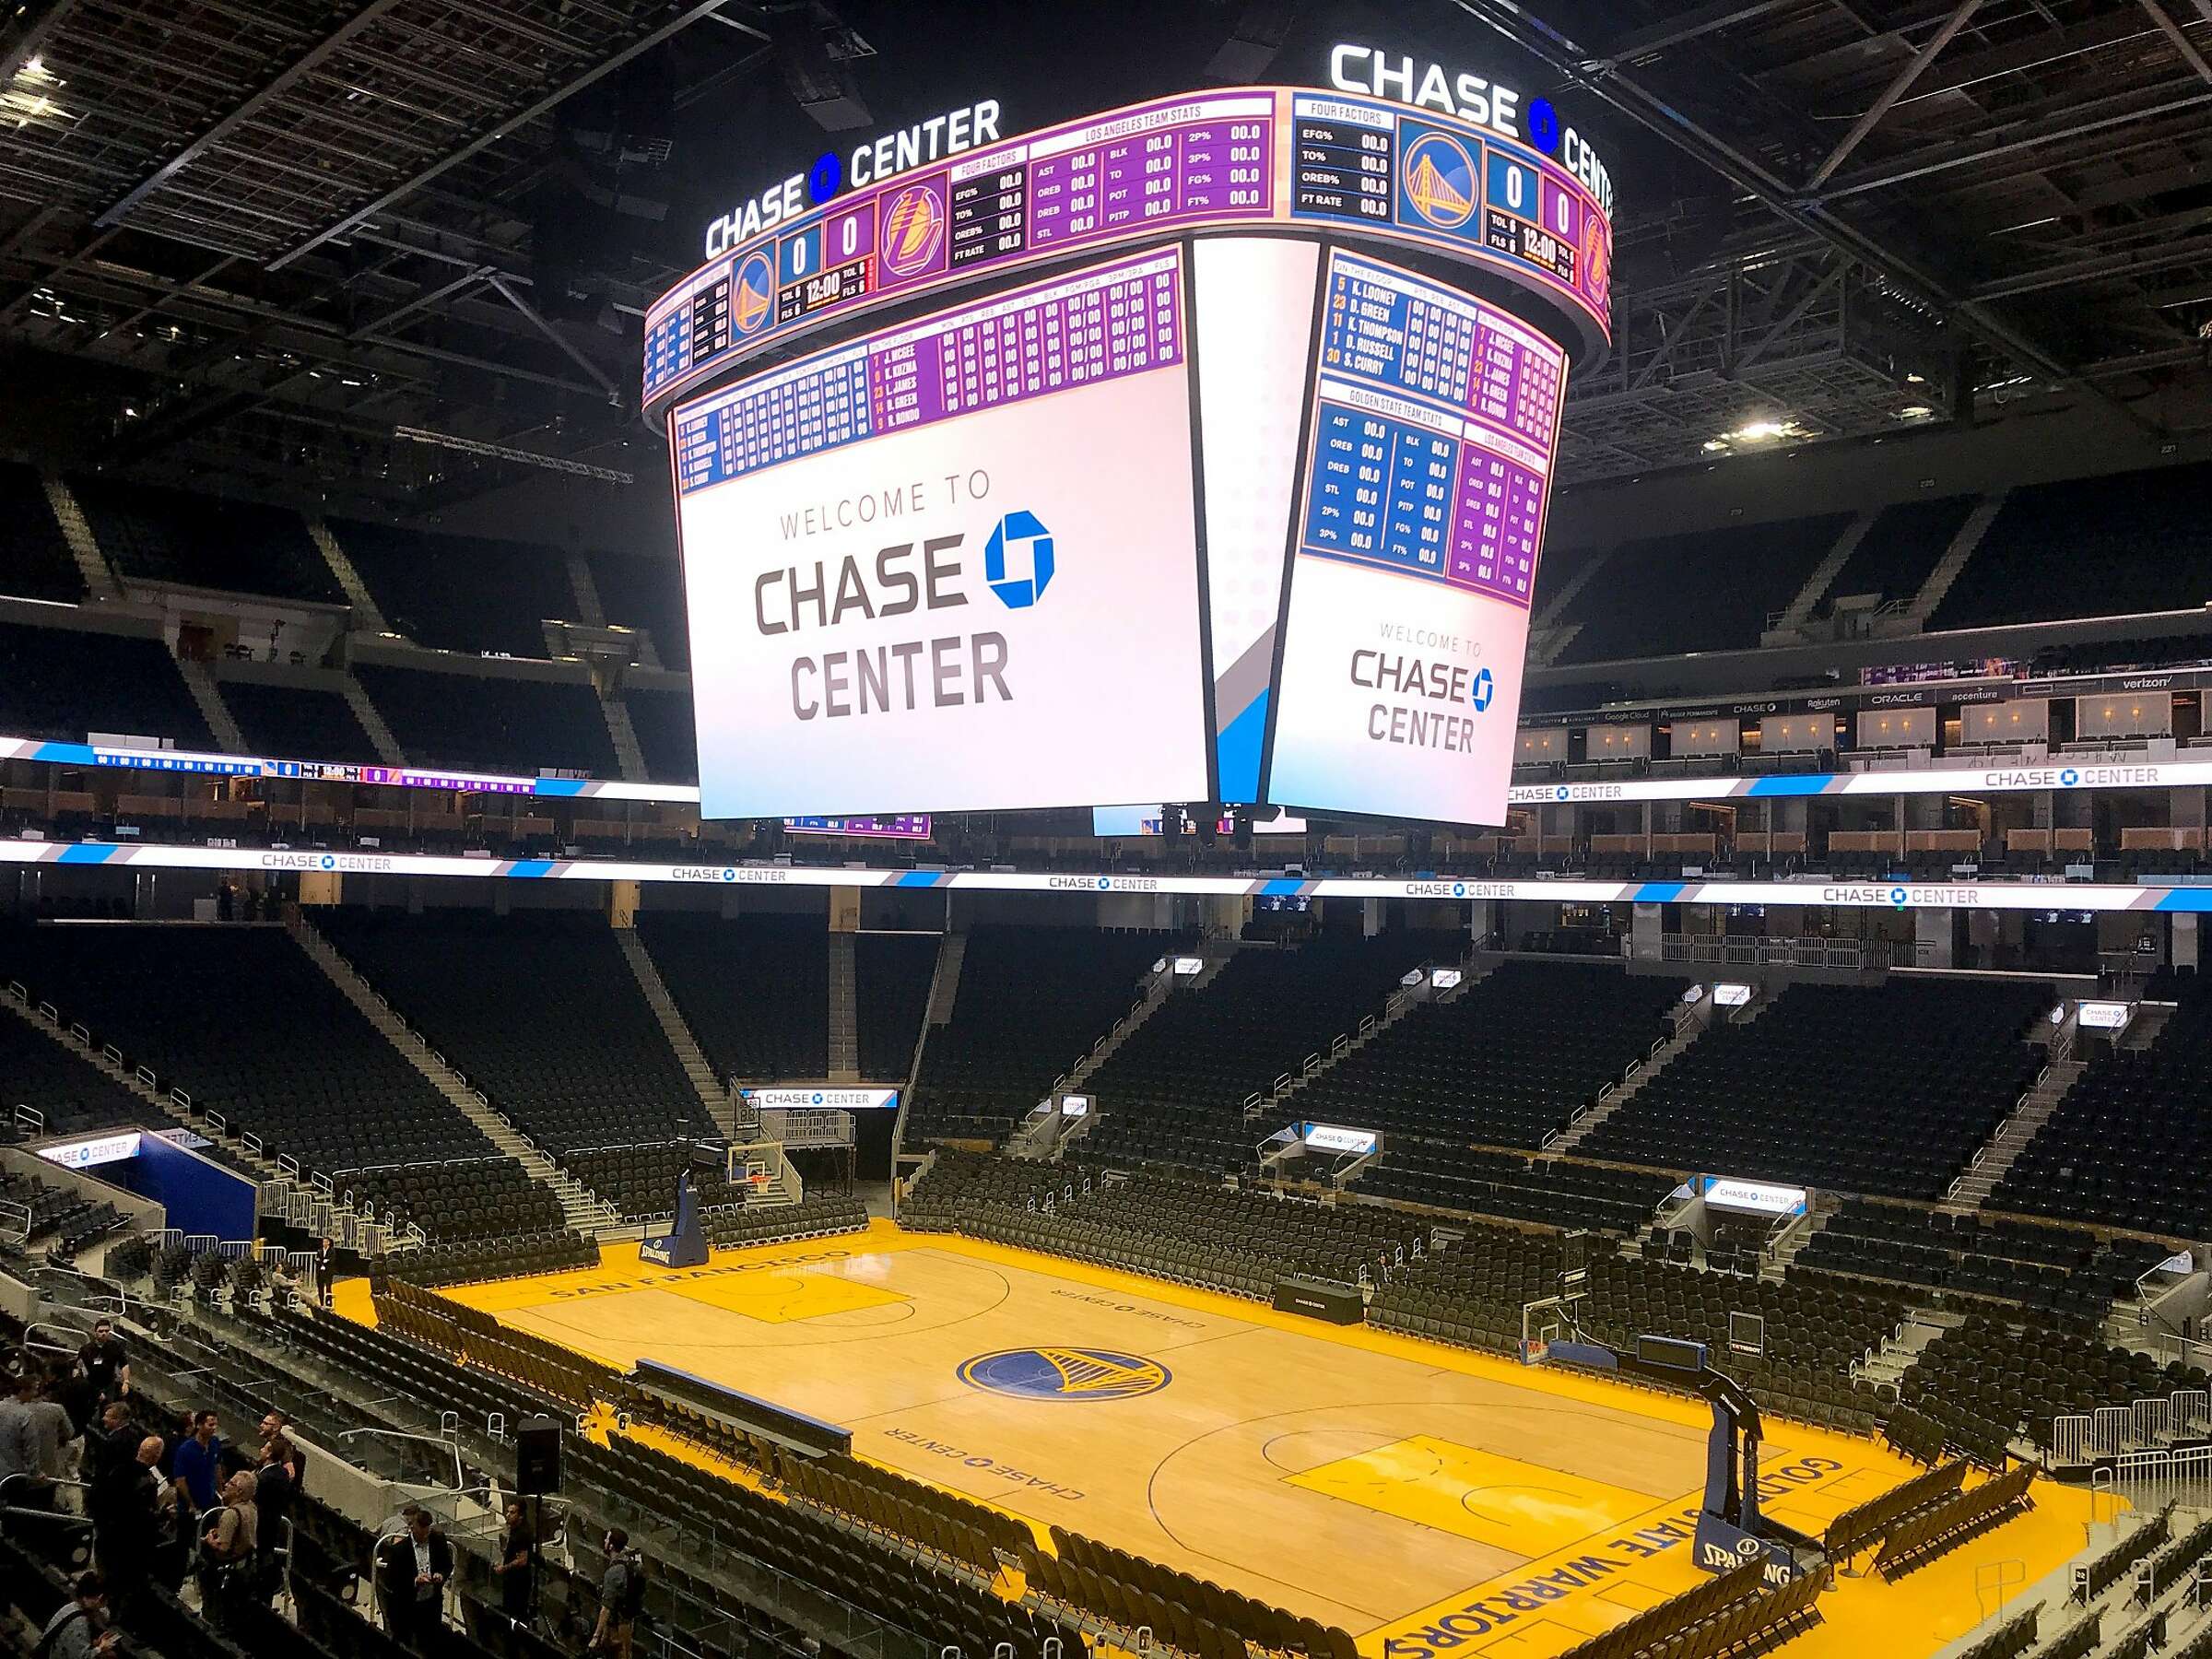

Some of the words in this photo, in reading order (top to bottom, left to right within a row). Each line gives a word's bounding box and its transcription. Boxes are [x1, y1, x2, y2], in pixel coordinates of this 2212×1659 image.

[1086, 127, 1102, 142] LOS
[1104, 118, 1141, 140] ANGELES
[1143, 112, 1169, 131] TEAM
[1171, 105, 1202, 123] STATS
[1311, 103, 1336, 117] FOUR
[1338, 107, 1382, 124] FACTORS
[1188, 132, 1211, 142] 2P%
[1231, 125, 1260, 140] 00.0
[1302, 129, 1333, 141] EFG%
[1361, 135, 1388, 152] 00.0
[1331, 43, 1520, 138] CHASE
[1564, 126, 1614, 221] CENTE
[1110, 147, 1128, 159] BLK
[1147, 135, 1172, 153] 00.0
[1188, 153, 1211, 163] 3P%
[1230, 147, 1260, 162] 00.0
[961, 159, 981, 177] FOUR
[982, 151, 1017, 171] FACTORS
[1038, 166, 1054, 177] AST
[1071, 153, 1095, 171] 00.0
[1110, 170, 1122, 181] TO
[1146, 156, 1172, 173] 00.0
[1302, 151, 1326, 162] TO%
[1361, 156, 1388, 173] 00.0
[705, 172, 806, 261] CHASE
[850, 100, 1001, 188] CENTER
[955, 187, 978, 201] EFG%
[999, 172, 1022, 190] 00.0
[1038, 184, 1061, 198] OREB
[1071, 173, 1095, 192] 00.0
[1188, 173, 1211, 184] FG%
[1230, 168, 1259, 183] 00.0
[1301, 172, 1340, 185] OREB%
[1360, 177, 1388, 194] 00.0
[1507, 166, 1522, 208] 0
[1110, 189, 1128, 201] POT
[1145, 177, 1171, 195] 00.0
[1187, 195, 1209, 206] FT%
[1230, 190, 1259, 205] 00.0
[955, 208, 973, 220] TO%
[999, 193, 1021, 210] 00.0
[1038, 205, 1060, 218] DREB
[1070, 194, 1095, 212] 00.0
[1109, 209, 1130, 222] PITP
[1145, 199, 1171, 218] 00.0
[1301, 194, 1314, 205] FT
[1315, 195, 1342, 207] RATE
[1360, 199, 1387, 217] 00.0
[1558, 192, 1570, 234] 0
[955, 225, 982, 241] OREB%
[999, 214, 1021, 231] 00.0
[1037, 229, 1053, 240] STL
[1069, 216, 1094, 233] 00.0
[1491, 213, 1508, 229] TOL
[842, 216, 857, 255] 0
[955, 250, 964, 261] FT
[966, 245, 984, 258] RATE
[998, 233, 1021, 251] 00.0
[1491, 234, 1506, 249] FLS
[1523, 227, 1556, 257] 12:00
[793, 237, 806, 276] 0
[843, 267, 857, 278] TOL
[806, 272, 841, 302] 12:00
[842, 286, 855, 297] FLS
[1352, 280, 1360, 295] K.
[1362, 283, 1397, 306] LOONEY
[782, 310, 794, 321] FLS
[1350, 299, 1359, 313] D.
[1360, 302, 1390, 323] GREEN
[1347, 317, 1357, 332] K.
[1359, 320, 1404, 345] THOMPSON
[1346, 335, 1355, 350] D.
[1357, 339, 1394, 361] RUSSELL
[1344, 353, 1353, 367] S.
[1355, 356, 1384, 376] CURRY
[1349, 390, 1379, 407] GOLDEN
[1381, 397, 1403, 414] STATE
[1404, 404, 1421, 420] TEAM
[1423, 409, 1441, 427] STATS
[780, 483, 924, 540] WELCOME
[945, 469, 990, 504] TO
[755, 533, 969, 636] CHASE
[1381, 623, 1458, 653] WELCOME
[1465, 640, 1482, 657] TO
[791, 631, 1014, 721] CENTER
[1351, 649, 1469, 703] CHASE
[2124, 677, 2167, 689] verizon
[1807, 699, 1840, 709] Rakuten
[1871, 693, 1923, 704] ORACLE
[1952, 691, 1998, 701] accenture
[1606, 713, 1629, 722] Google
[1630, 712, 1650, 720] Cloud
[1734, 703, 1766, 713] CHASE
[1368, 704, 1475, 754] CENTER
[323, 767, 345, 778] 12:00
[1985, 772, 2055, 787] CHASE
[2085, 769, 2159, 783] CENTER
[1572, 785, 1622, 798] CENTER
[262, 853, 317, 868] CHASE
[339, 857, 391, 870] CENTER
[673, 868, 721, 880] CHASE
[739, 870, 785, 883] CENTER
[1049, 877, 1095, 888] CHASE
[1113, 879, 1158, 890] CENTER
[1406, 883, 1451, 896] CHASE
[1468, 885, 1515, 897] CENTER
[1823, 888, 1886, 903] CHASE
[1912, 889, 1978, 904] CENTER
[765, 1093, 809, 1104] CHASE
[827, 1093, 870, 1104] CENTER
[1315, 1134, 1335, 1142] CHASE
[92, 1142, 127, 1158] CENTER
[1720, 1188, 1749, 1199] CHASE
[1760, 1194, 1789, 1204] CENTER
[641, 1244, 670, 1265] SPALDING
[549, 1282, 633, 1298] SAN
[639, 1249, 852, 1285] FRANCISCO
[1051, 1288, 1112, 1311] CENTER
[1138, 1309, 1206, 1329] CHASE
[883, 1428, 970, 1460] CENTER
[988, 1464, 1086, 1500] CHASE
[1388, 1556, 1631, 1659] WARRIORS
